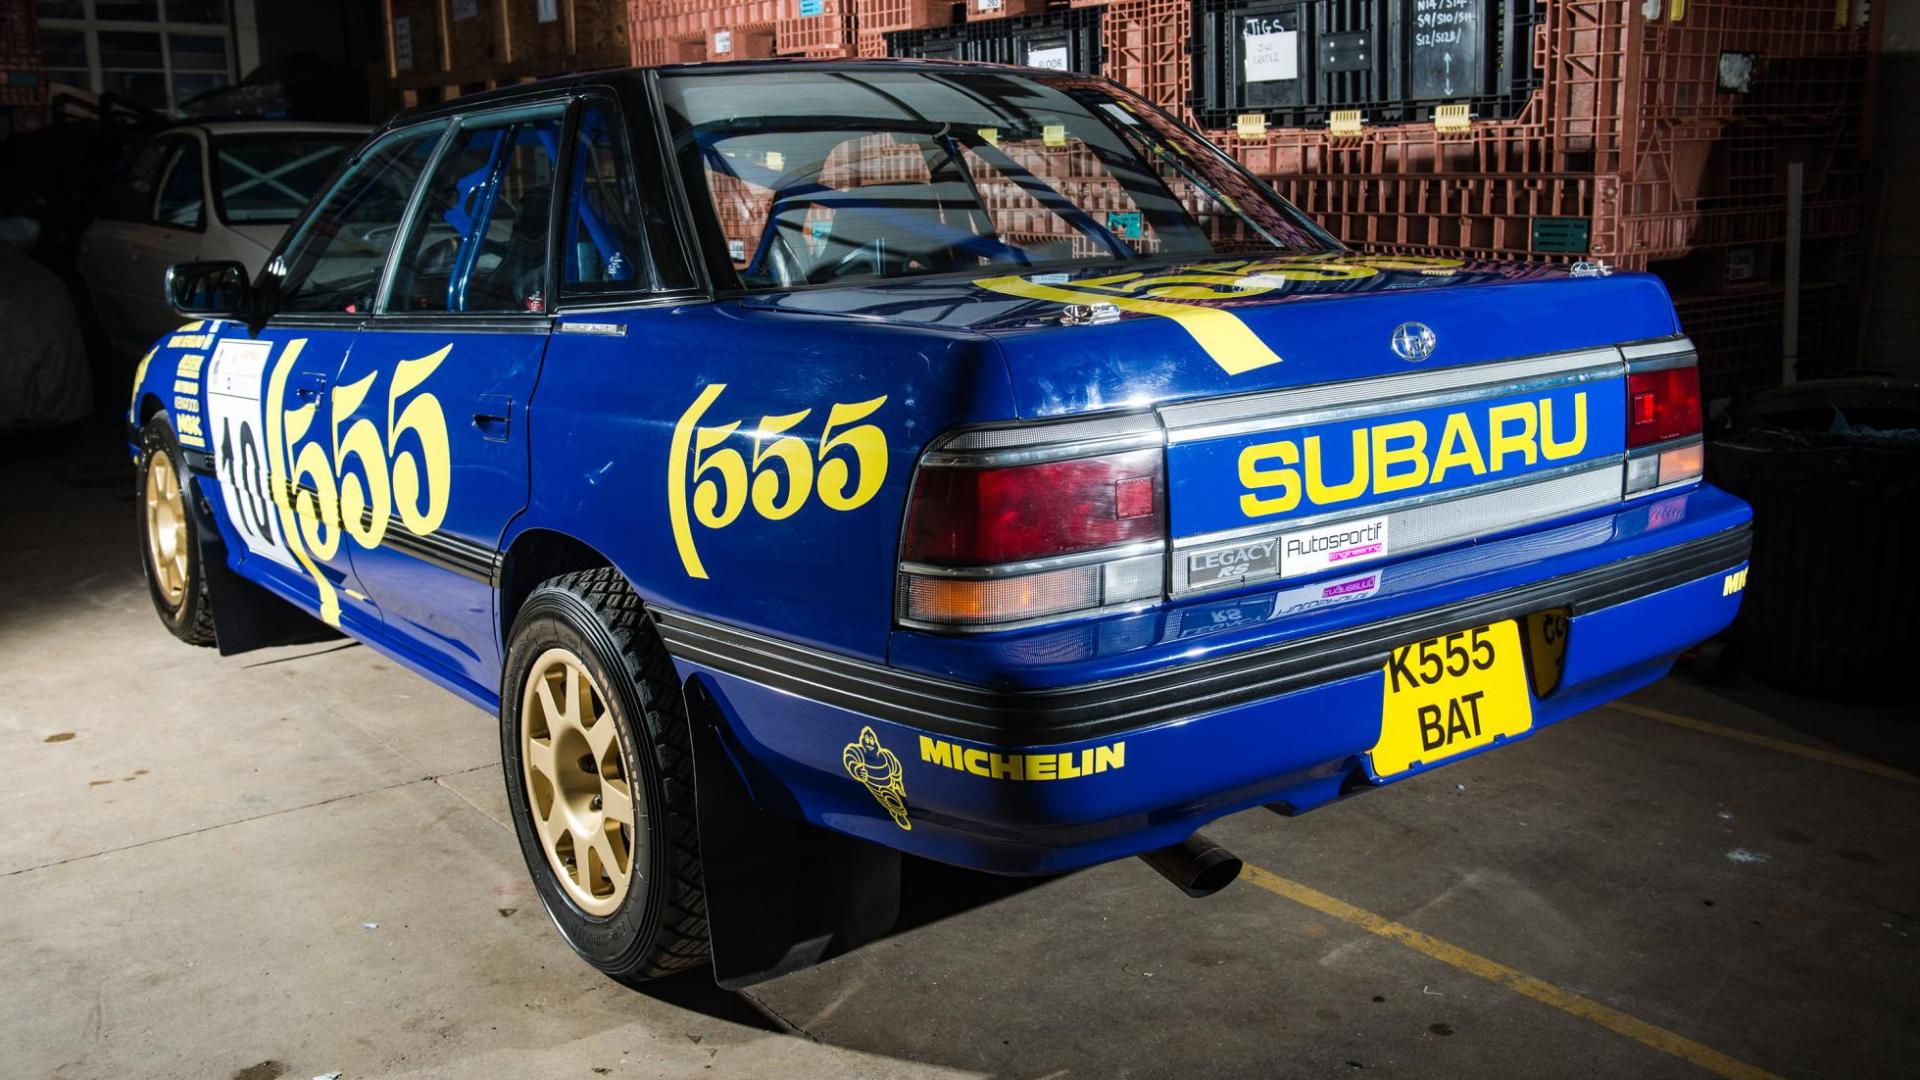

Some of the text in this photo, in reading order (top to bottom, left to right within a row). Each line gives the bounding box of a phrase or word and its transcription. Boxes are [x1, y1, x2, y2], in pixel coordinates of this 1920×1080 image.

[221, 416, 275, 546] 10
[693, 395, 889, 529] 555
[1238, 392, 1588, 518] SUBARU
[1191, 542, 1275, 572] LEGACY
[1217, 563, 1250, 578] RS
[1287, 522, 1382, 558] Autosportif
[1389, 625, 1495, 694] K555
[1417, 690, 1485, 752] BAT
[919, 735, 1126, 782] MICHELIN
